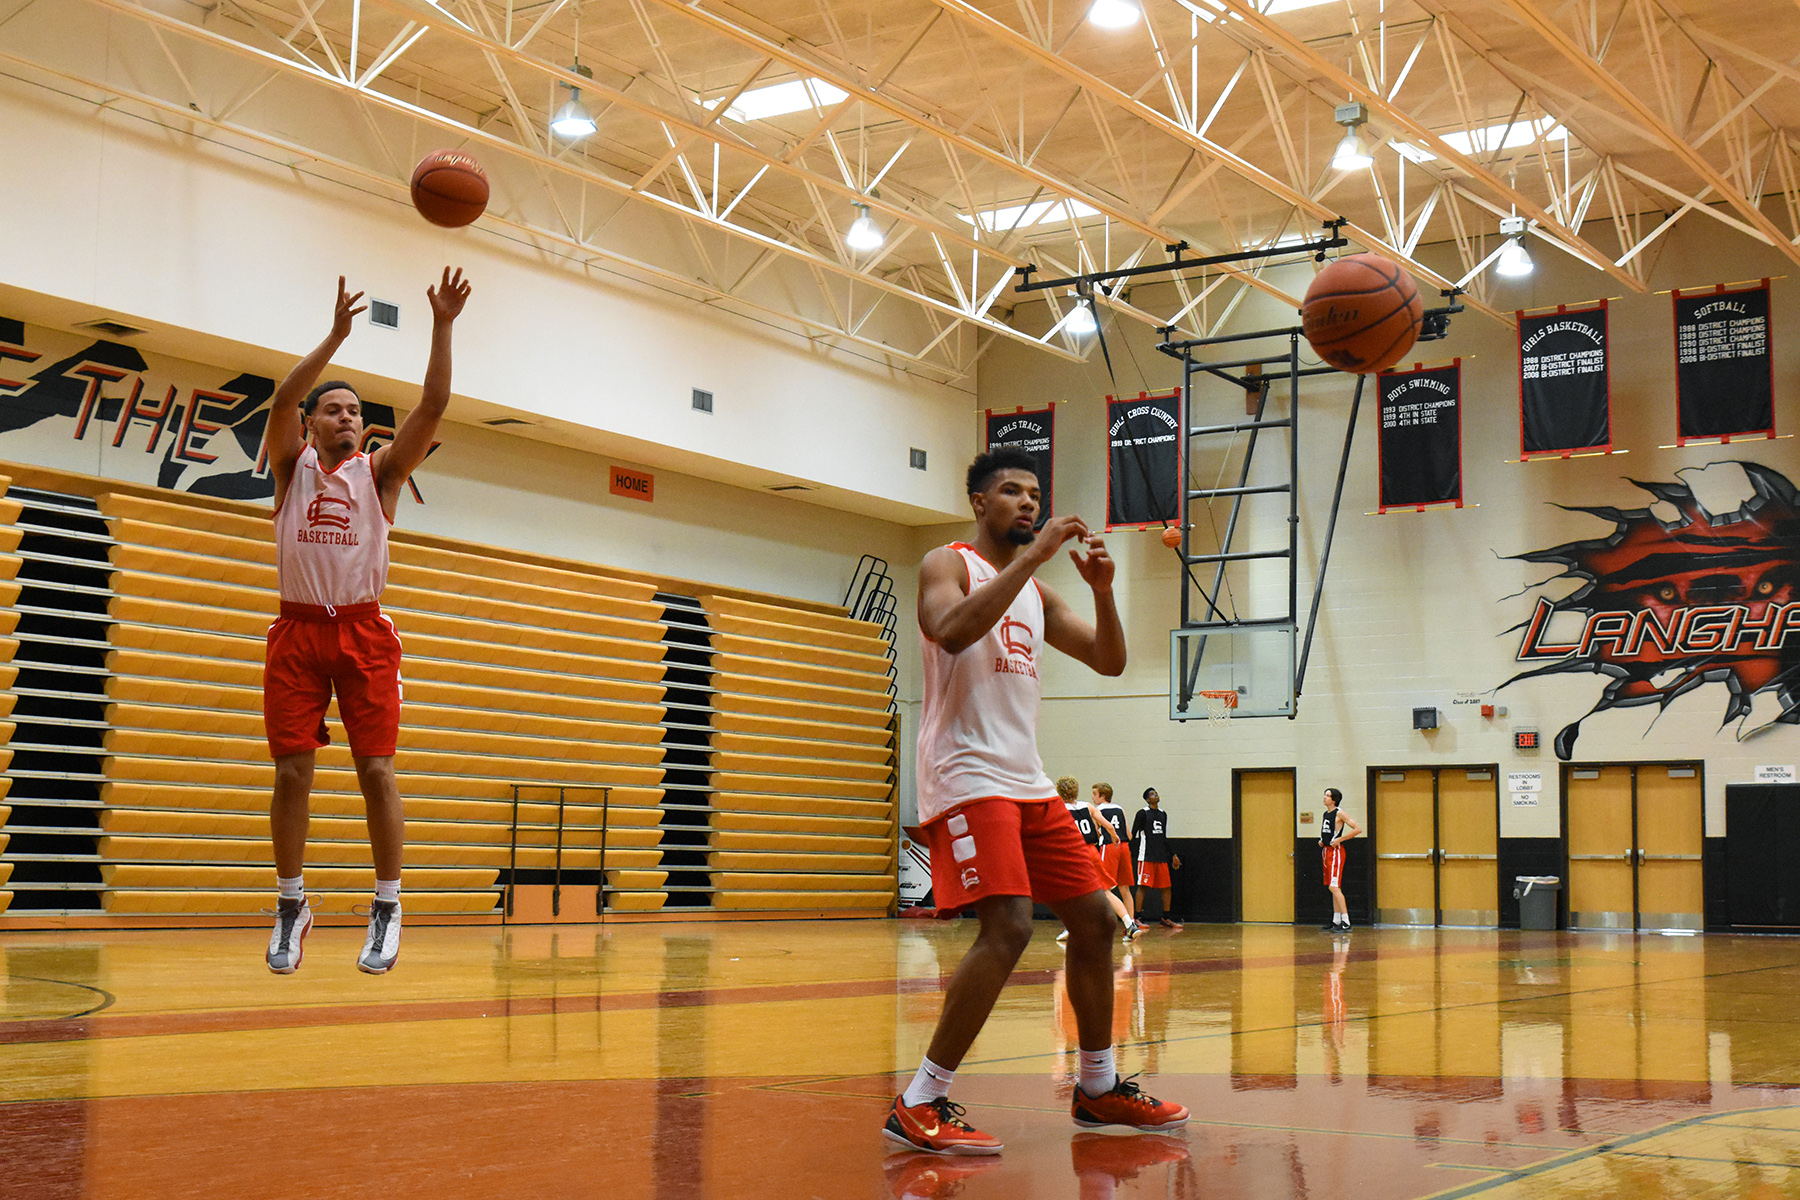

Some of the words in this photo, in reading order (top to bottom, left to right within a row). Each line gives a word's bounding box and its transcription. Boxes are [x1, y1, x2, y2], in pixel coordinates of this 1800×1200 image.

[1694, 301, 1746, 320] SOFTBALL
[1698, 320, 1727, 330] DISTRICT
[1729, 316, 1766, 327] CHAMPIONS
[1522, 328, 1546, 352] GIRLS
[1546, 321, 1604, 345] BASKETBALL
[1698, 328, 1728, 338] DISTRICT
[1729, 324, 1766, 335] CHAMPIONS
[1698, 336, 1728, 346] DISTRICT
[1730, 332, 1766, 343] CHAMPIONS
[1699, 343, 1735, 354] BI-DISTRICT
[1736, 340, 1766, 350] FINALIST
[1541, 354, 1567, 363] DISTRICT
[1569, 349, 1604, 360] CHAMPIONS
[1700, 351, 1736, 362] BI-DISTRICT
[1737, 347, 1766, 358] FINALIST
[1541, 360, 1574, 370] BI-DISTRICT
[1577, 356, 1604, 366] FINALIST
[1541, 368, 1574, 378] BI-DISTRICT
[1578, 364, 1604, 374] FINALIST
[1387, 384, 1407, 402] BOYS
[1408, 378, 1450, 394] SWIMMING
[1398, 403, 1422, 412] DISTRICT
[1424, 400, 1456, 410] CHAMPIONS
[66, 361, 247, 466] THE
[1127, 406, 1149, 419] CROSS
[1150, 407, 1178, 429] COUNTRY
[1420, 416, 1438, 424] STATE
[997, 422, 1017, 438] GIRLS
[1018, 420, 1042, 434] TRACK
[1024, 438, 1050, 446] CHAMPIONS
[1124, 438, 1146, 446] DIRICT
[1148, 434, 1176, 444] CHAMPIONS
[616, 474, 648, 493] HOME
[297, 530, 358, 546] BASKETBALL
[995, 657, 1038, 681] BASKETBA
[1519, 734, 1534, 746] EXIT
[1110, 815, 1119, 829] 4
